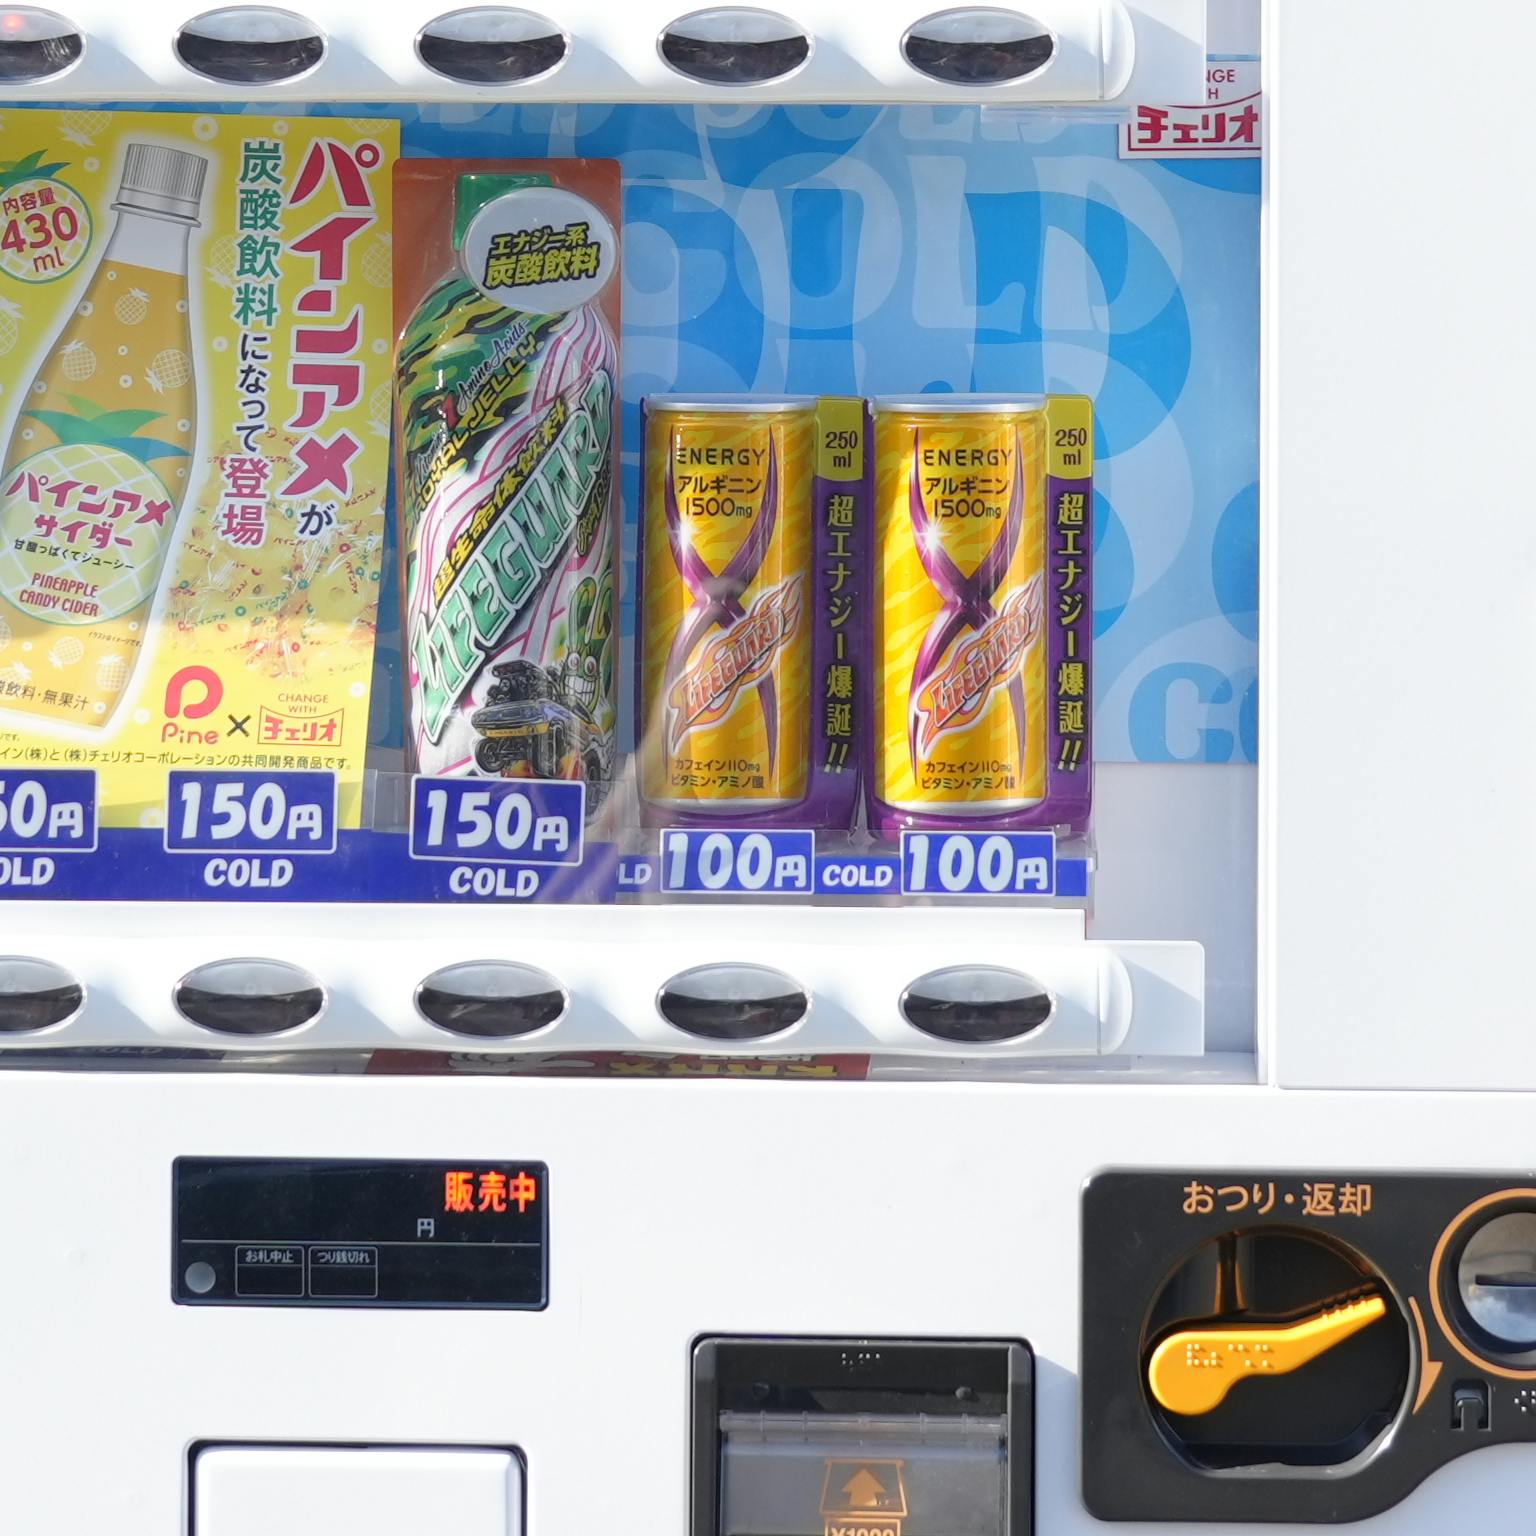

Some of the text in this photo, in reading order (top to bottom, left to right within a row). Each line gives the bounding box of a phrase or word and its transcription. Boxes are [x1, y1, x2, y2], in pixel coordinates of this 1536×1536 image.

[484, 245, 601, 289] 炭酸飲料
[222, 138, 284, 546] 炭酸飲料になって登場
[280, 138, 384, 538] パインアメが
[1054, 428, 1089, 451] 250
[922, 446, 1012, 467] ENERGY
[1061, 451, 1082, 468] ml
[924, 473, 1008, 497] アルギニン
[932, 496, 1002, 520] 1500mg
[27, 571, 100, 601] PINEAPPLE
[18, 589, 100, 617] CANDY CIDER
[277, 692, 330, 705] CHANGE
[160, 720, 220, 746] Pine
[263, 717, 338, 743] チェリオ
[181, 781, 324, 841] 150円
[426, 789, 570, 852] 150円
[203, 858, 294, 888] COLD
[910, 835, 1047, 892] 100円
[449, 867, 541, 899] COLD
[444, 1170, 537, 1214] 販売中
[1182, 1181, 1373, 1217] おつり・返却
[416, 1217, 436, 1239] 円
[245, 1248, 294, 1265] お札中止
[316, 1249, 371, 1265] つり銭切れ
